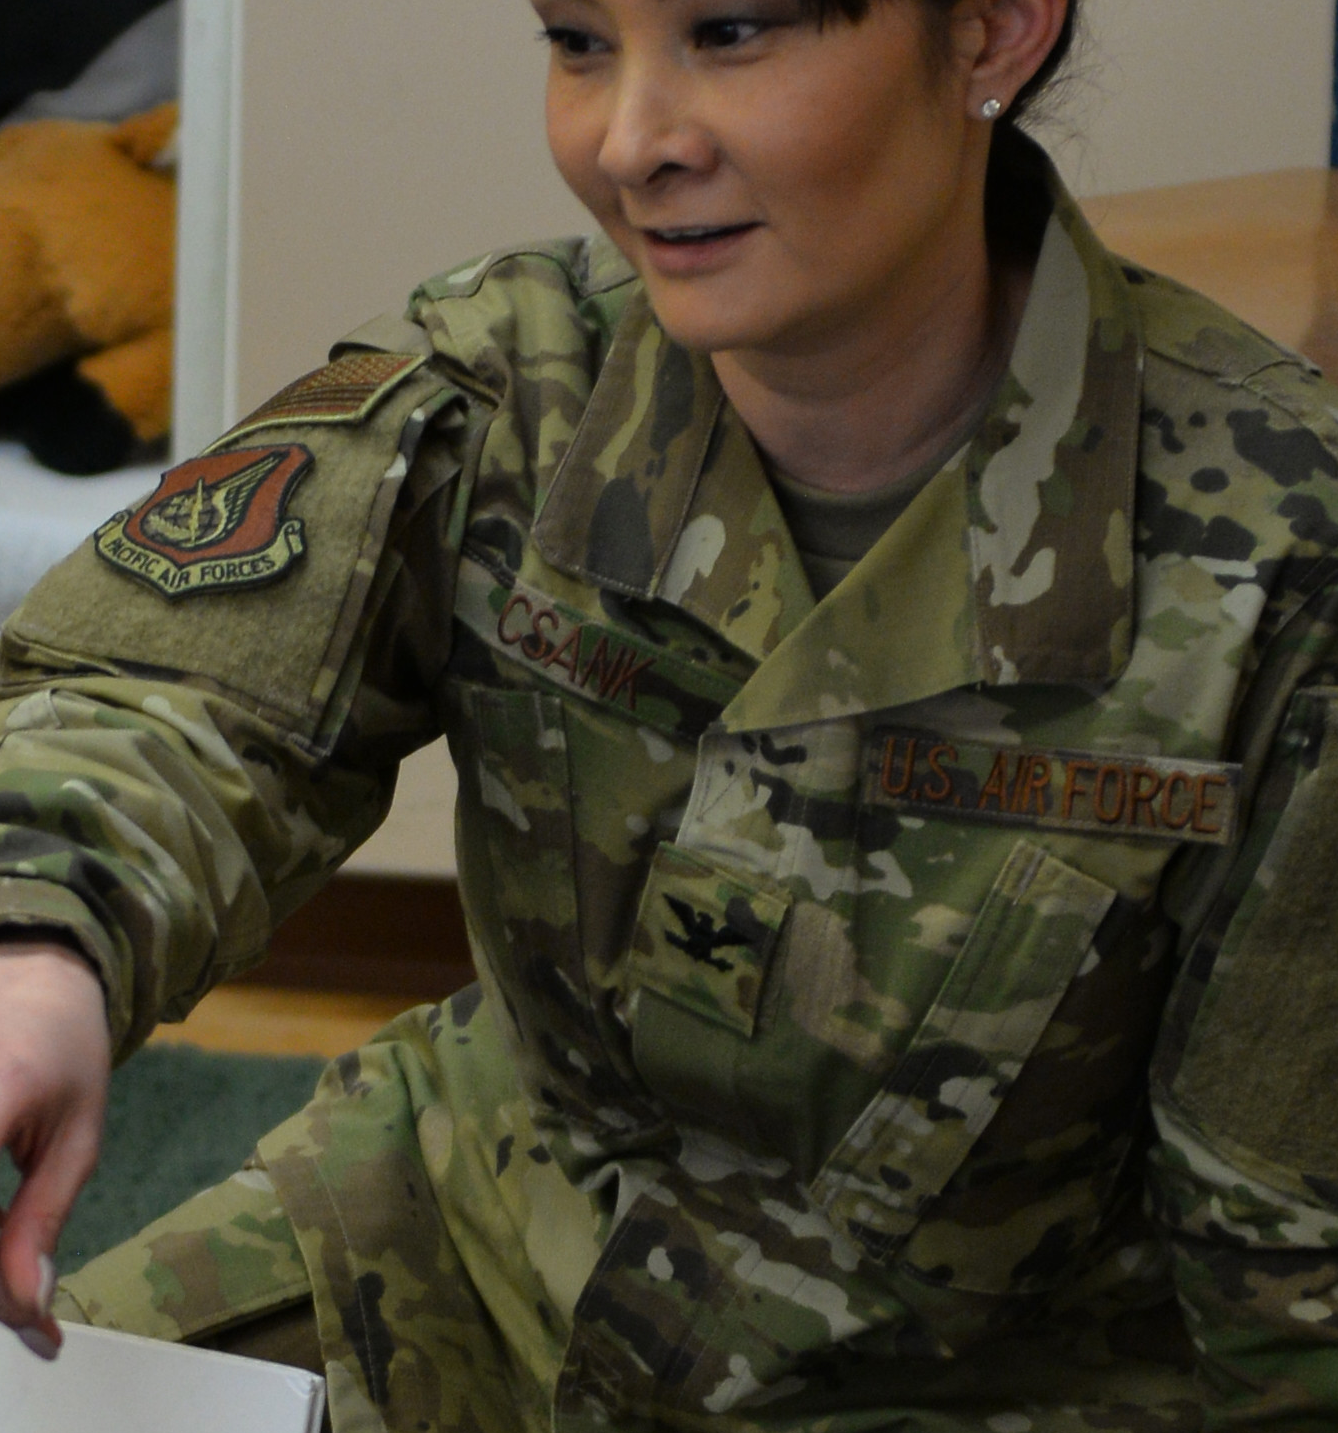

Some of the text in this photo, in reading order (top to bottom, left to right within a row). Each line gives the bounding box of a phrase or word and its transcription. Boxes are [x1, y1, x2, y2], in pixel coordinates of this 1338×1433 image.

[104, 538, 275, 588] PACIFIC AIR FORCES
[497, 593, 657, 711] CSANK
[880, 737, 1228, 833] U.S. AIR FORCE
